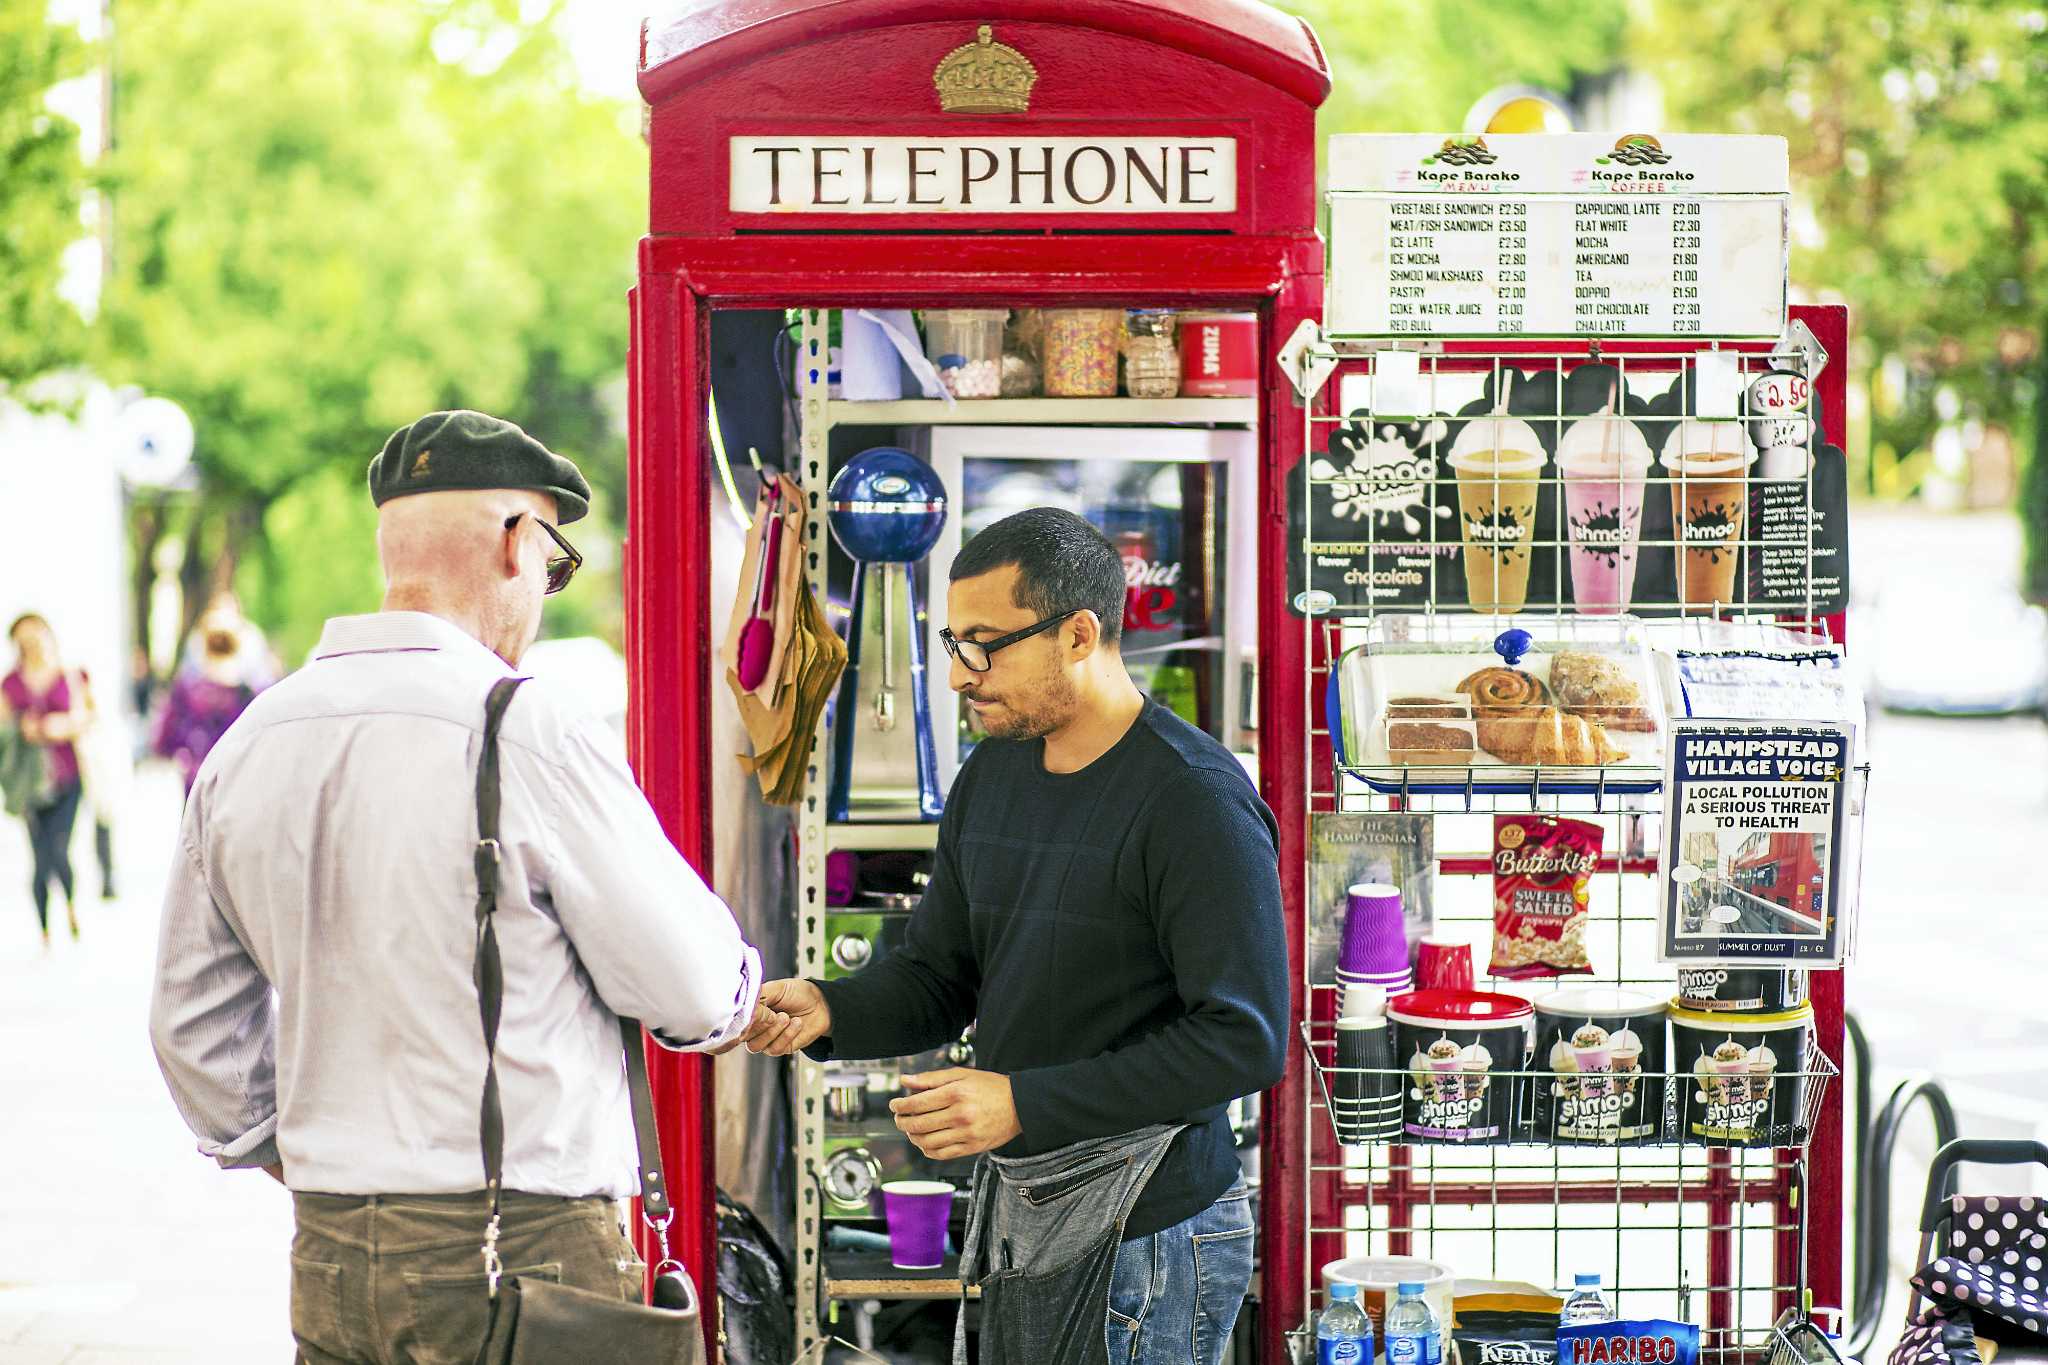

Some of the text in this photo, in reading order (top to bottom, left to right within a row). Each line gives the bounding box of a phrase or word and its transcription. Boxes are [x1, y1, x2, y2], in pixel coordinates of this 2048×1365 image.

[752, 146, 1216, 206] TELEPHONE
[1417, 170, 1520, 182] Kape Barako
[1592, 170, 1695, 182] Kape Barako
[1443, 183, 1490, 191] MENU
[1611, 182, 1665, 192] COFFEE
[1390, 203, 1526, 215] VEGETABLE SANDWICH £2.50
[1633, 203, 1660, 215] LATTE
[1673, 203, 1700, 215] £2.00
[1390, 220, 1526, 232] MEAT/FISH SANDWICH £3.50
[1575, 220, 1700, 232] FLAT WHITE £2.30
[1390, 237, 1526, 248] ICE LATTE £2.50
[1575, 237, 1700, 248] MOCHA £2.30
[1390, 253, 1526, 265] ICE MOCHA £2.80
[1575, 253, 1698, 265] AMERICANO £1.80
[1390, 270, 1526, 281] SHMOO MILKSHAKES £2.50
[1575, 270, 1698, 281] TEA £1.00
[1390, 287, 1526, 298] PASTRY £2.00
[1575, 287, 1698, 298] DOPPIO £1.50
[1456, 303, 1481, 315] JUICE
[1498, 303, 1522, 315] £1.00
[1575, 303, 1700, 315] HOT CHOCOLATE £2.30
[1390, 320, 1522, 331] RED BULL £1.50
[1575, 320, 1700, 331] CHAI LATTE £2.30
[1331, 458, 1438, 500] shmoo
[1470, 522, 1526, 540] shmoo
[1576, 525, 1633, 541] shmoo
[1684, 521, 1736, 540] shmoo
[1317, 556, 1351, 567] flavour
[1398, 556, 1431, 567] flavour
[1121, 556, 1181, 587] Diet
[1344, 568, 1423, 585] chocolate
[1685, 740, 1839, 758] HAMPSTEAD
[1685, 759, 1836, 776] VILLAGE VOICE
[1689, 787, 1828, 799] LOCAL POLLUTION
[1686, 802, 1830, 814] A SERIOUS THREAT
[1360, 821, 1382, 831] THE
[1715, 816, 1799, 828] TO HEALTH
[1324, 831, 1417, 844] HAMPSTONIAN
[1496, 849, 1598, 875] Butterkist
[1516, 889, 1561, 901] SWEET
[1514, 902, 1574, 915] SALTED
[1719, 943, 1786, 951] SUMMER OF DUST
[1680, 970, 1728, 988] shmoo
[1423, 1097, 1483, 1118] shmoo
[1562, 1091, 1636, 1118] shmoo
[1707, 1099, 1768, 1120] shmoo
[1477, 1342, 1554, 1364] KETTLE
[1573, 1336, 1676, 1364] HARIBO
